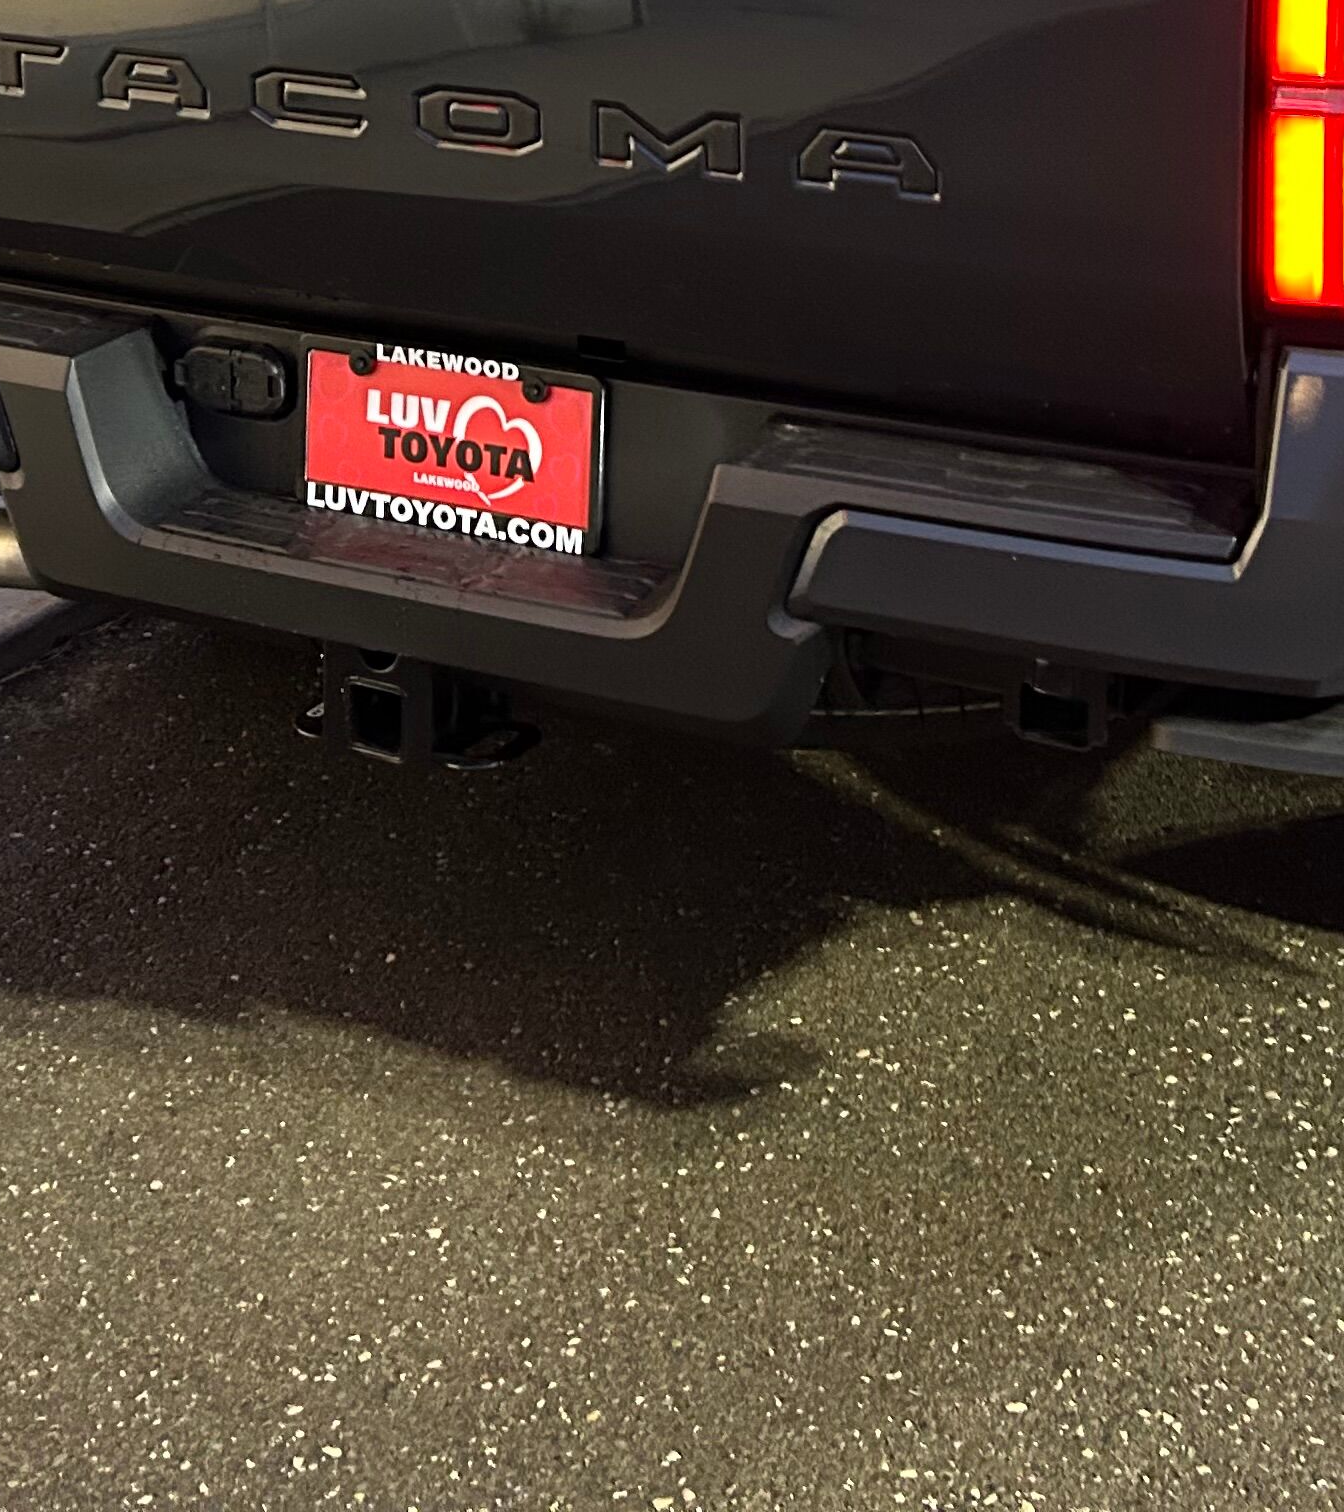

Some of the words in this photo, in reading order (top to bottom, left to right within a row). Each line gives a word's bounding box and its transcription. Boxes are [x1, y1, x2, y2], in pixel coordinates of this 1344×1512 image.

[376, 343, 520, 382] LAKEWOOD
[367, 388, 451, 433] LUV
[378, 426, 535, 482] TOYOTA
[413, 472, 480, 492] LAKEWOOD
[306, 481, 583, 555] LUVTOYOTA.COM
